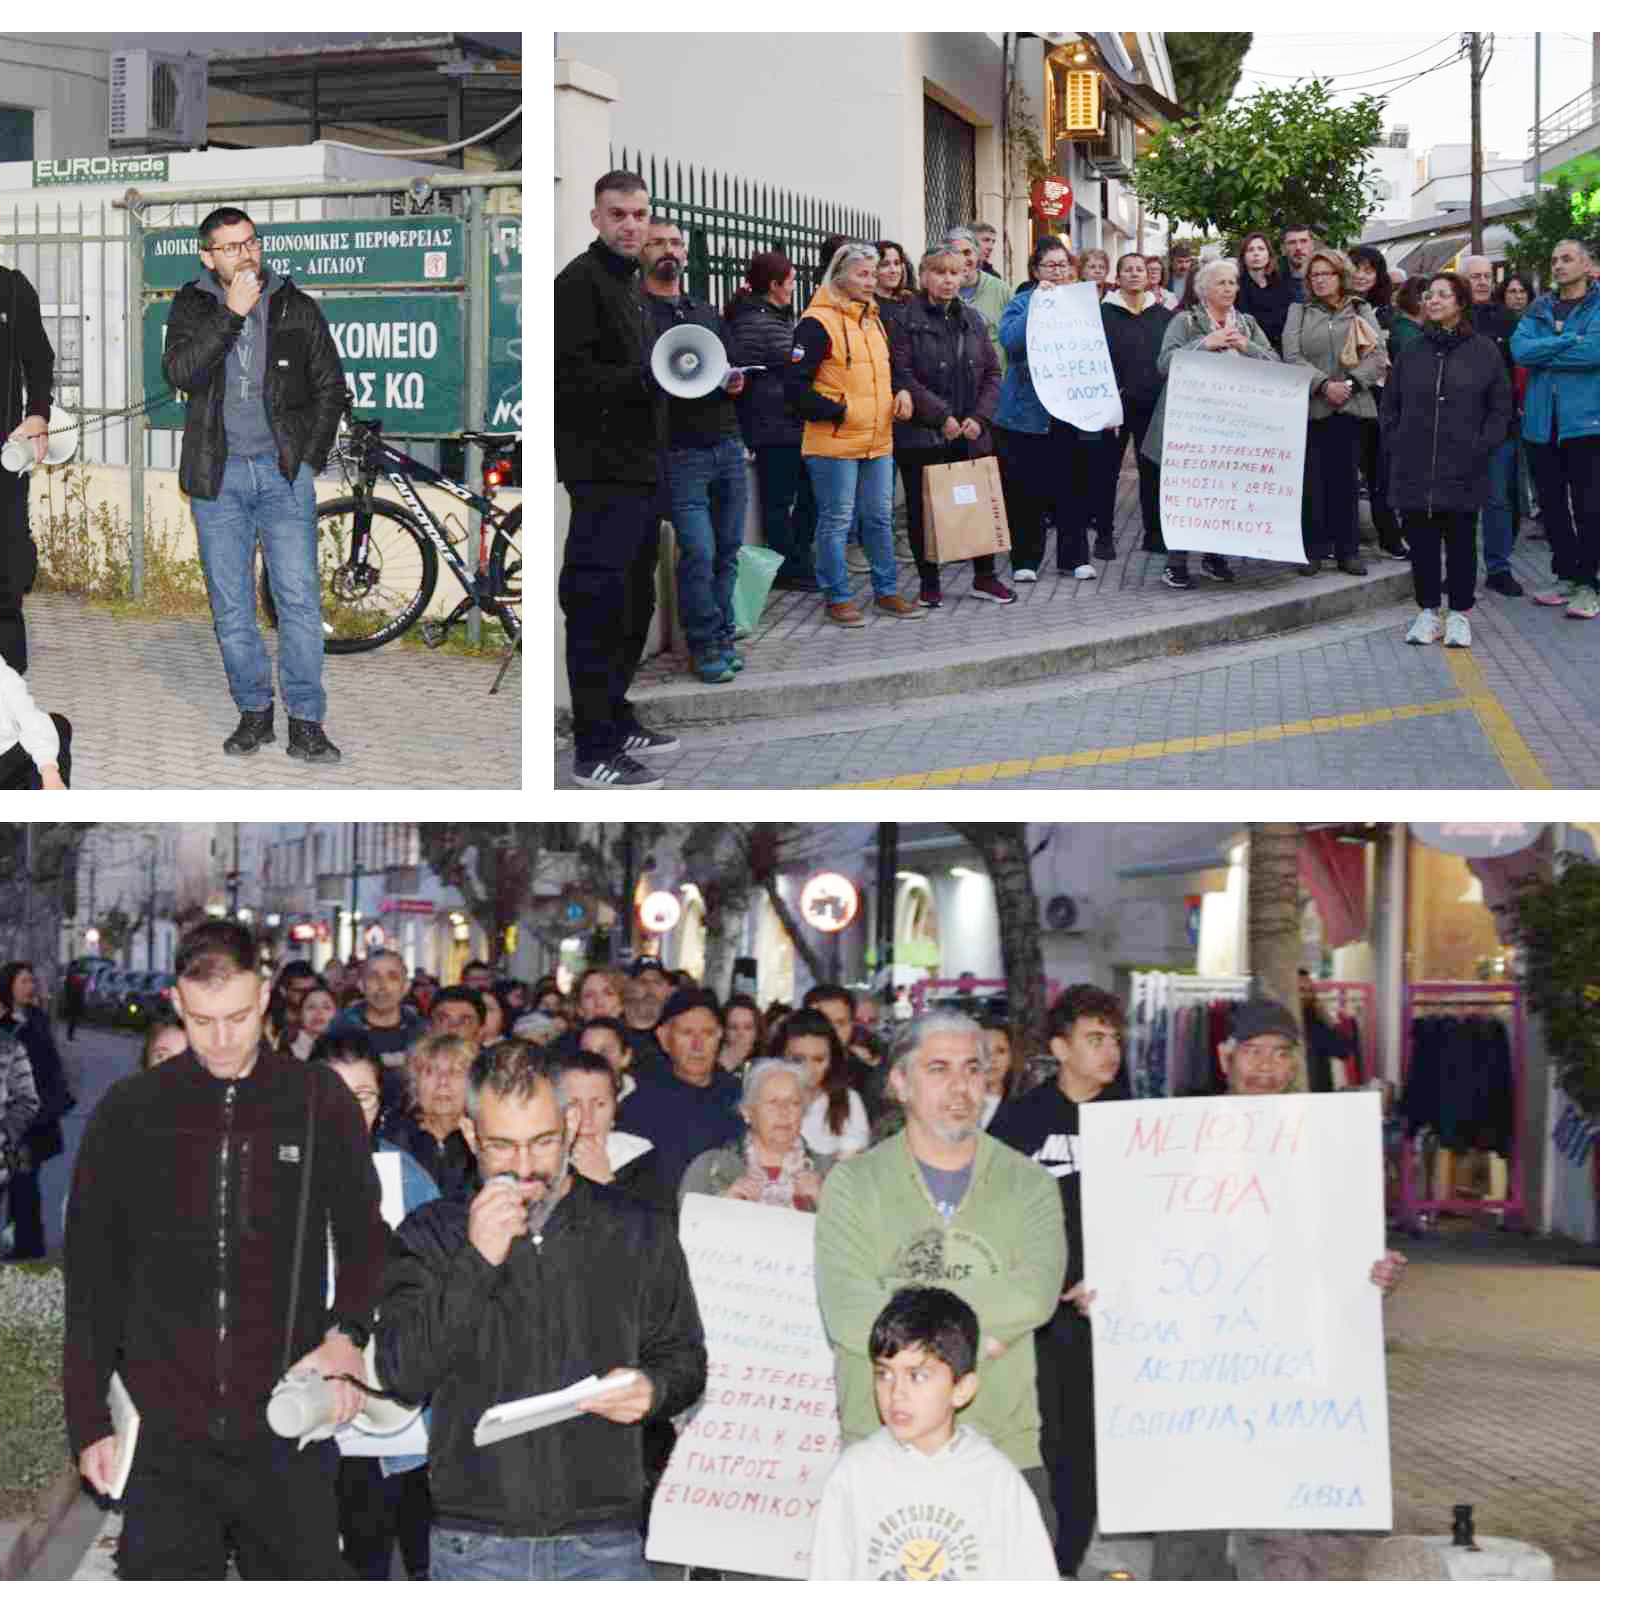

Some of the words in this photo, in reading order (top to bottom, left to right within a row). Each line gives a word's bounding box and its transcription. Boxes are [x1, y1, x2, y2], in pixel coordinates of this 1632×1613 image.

[37, 156, 166, 177] EUROtrade
[355, 228, 452, 249] ΠΕΡΙΦΕΡΕΙΑΣ
[307, 255, 368, 275] ΑΙΓΑΙΟΥ
[385, 371, 424, 409] ΚΩ
